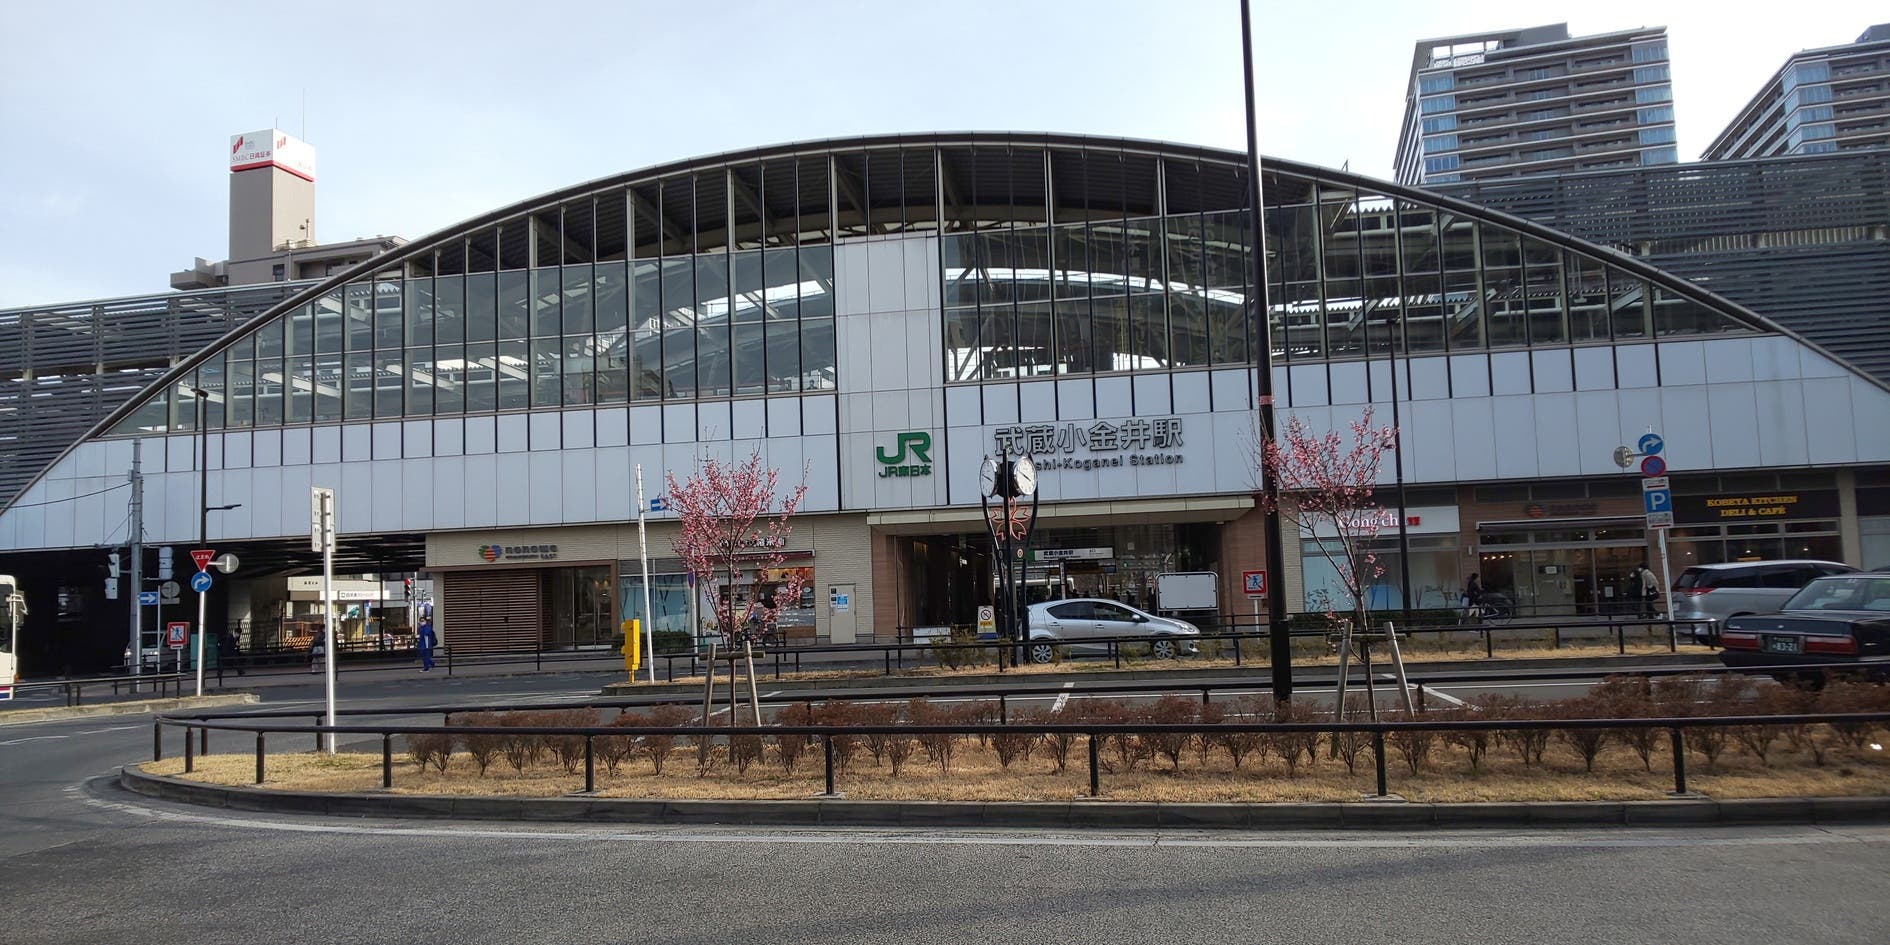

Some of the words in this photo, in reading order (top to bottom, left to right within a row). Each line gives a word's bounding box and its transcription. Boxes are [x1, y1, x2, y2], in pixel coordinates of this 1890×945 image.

[994, 417, 1184, 456] 武蔵小金井駅
[876, 431, 932, 465] JR
[1035, 454, 1123, 471] shi-Koganei
[1129, 453, 1184, 466] Station
[878, 463, 932, 478] JR東日本
[1650, 492, 1666, 511] P
[1706, 497, 1749, 507] KOBEYA
[1751, 495, 1798, 505] KITCHEN
[1381, 513, 1408, 528] ch
[1720, 508, 1746, 517] DELI
[1747, 508, 1757, 516] &
